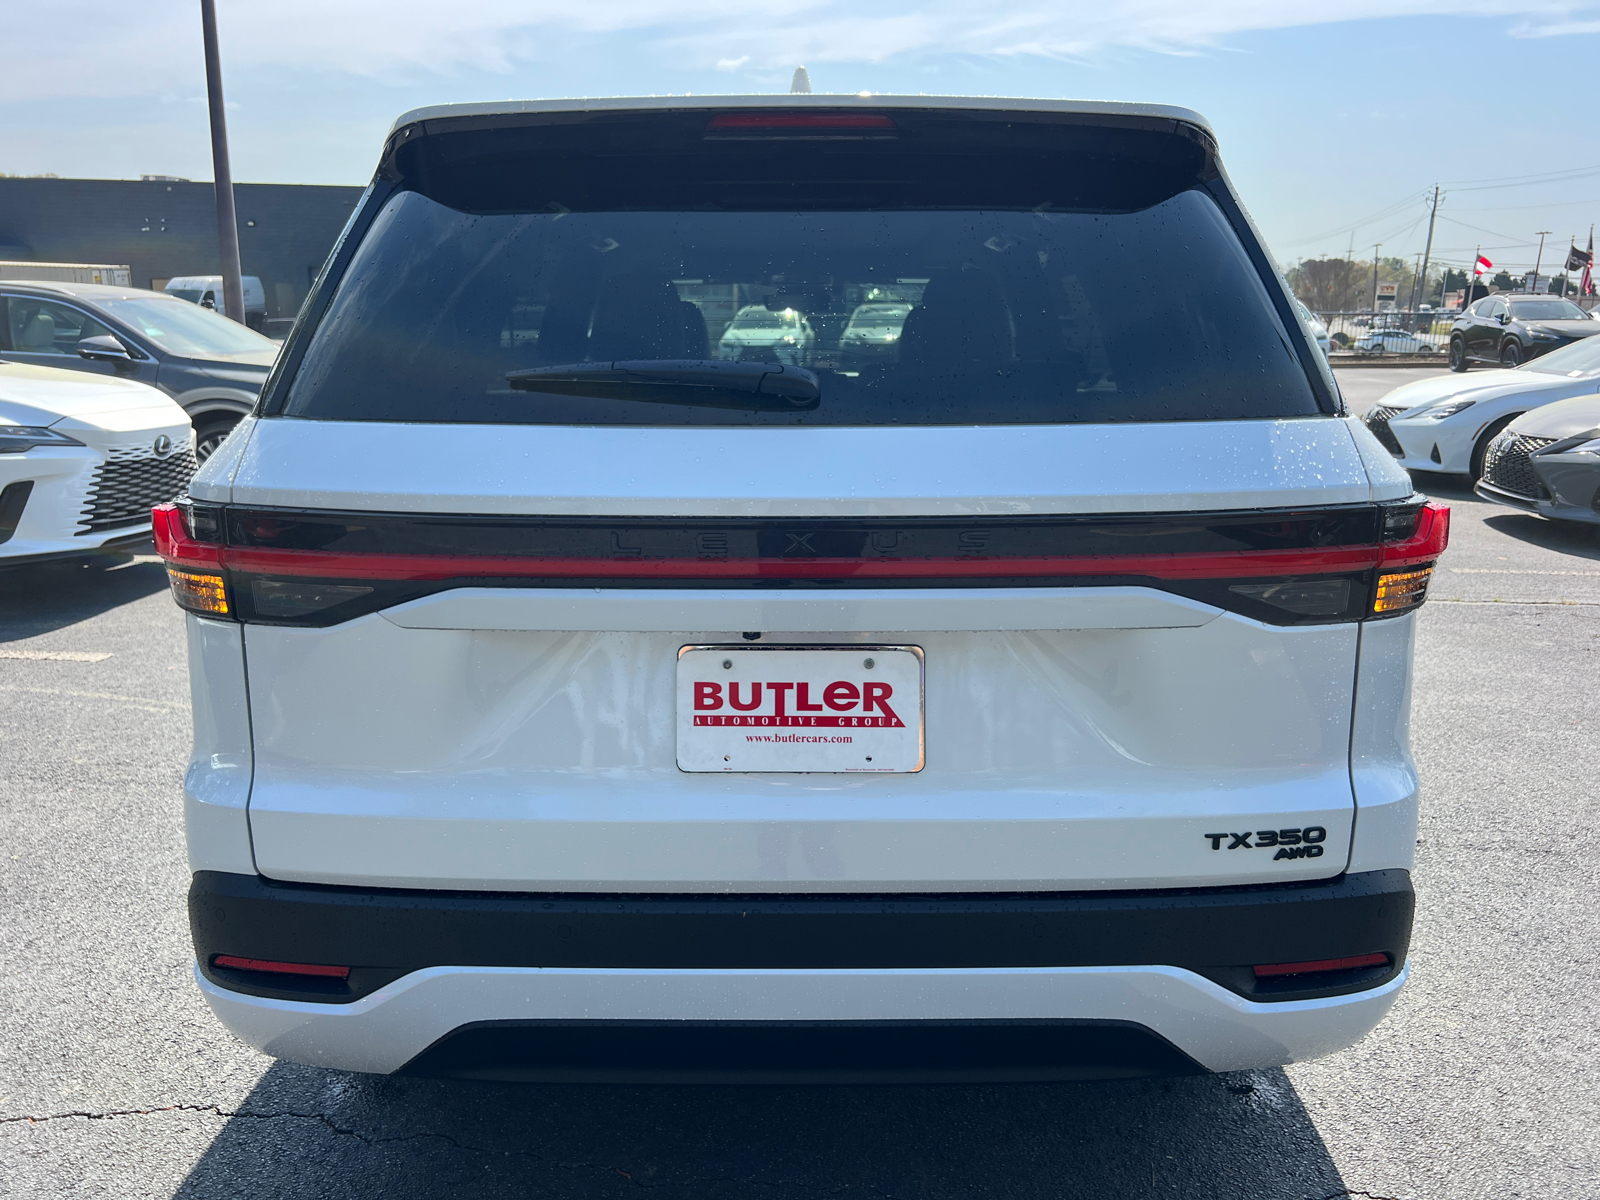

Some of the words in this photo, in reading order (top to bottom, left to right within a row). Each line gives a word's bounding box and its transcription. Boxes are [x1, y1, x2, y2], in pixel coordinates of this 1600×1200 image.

[610, 530, 992, 554] LEXUS
[694, 716, 817, 727] AUTOMOTIVE
[838, 716, 898, 727] GROUP
[745, 733, 853, 744] www.butlercars.com
[1204, 826, 1327, 851] TX350
[1273, 845, 1324, 861] AWD
